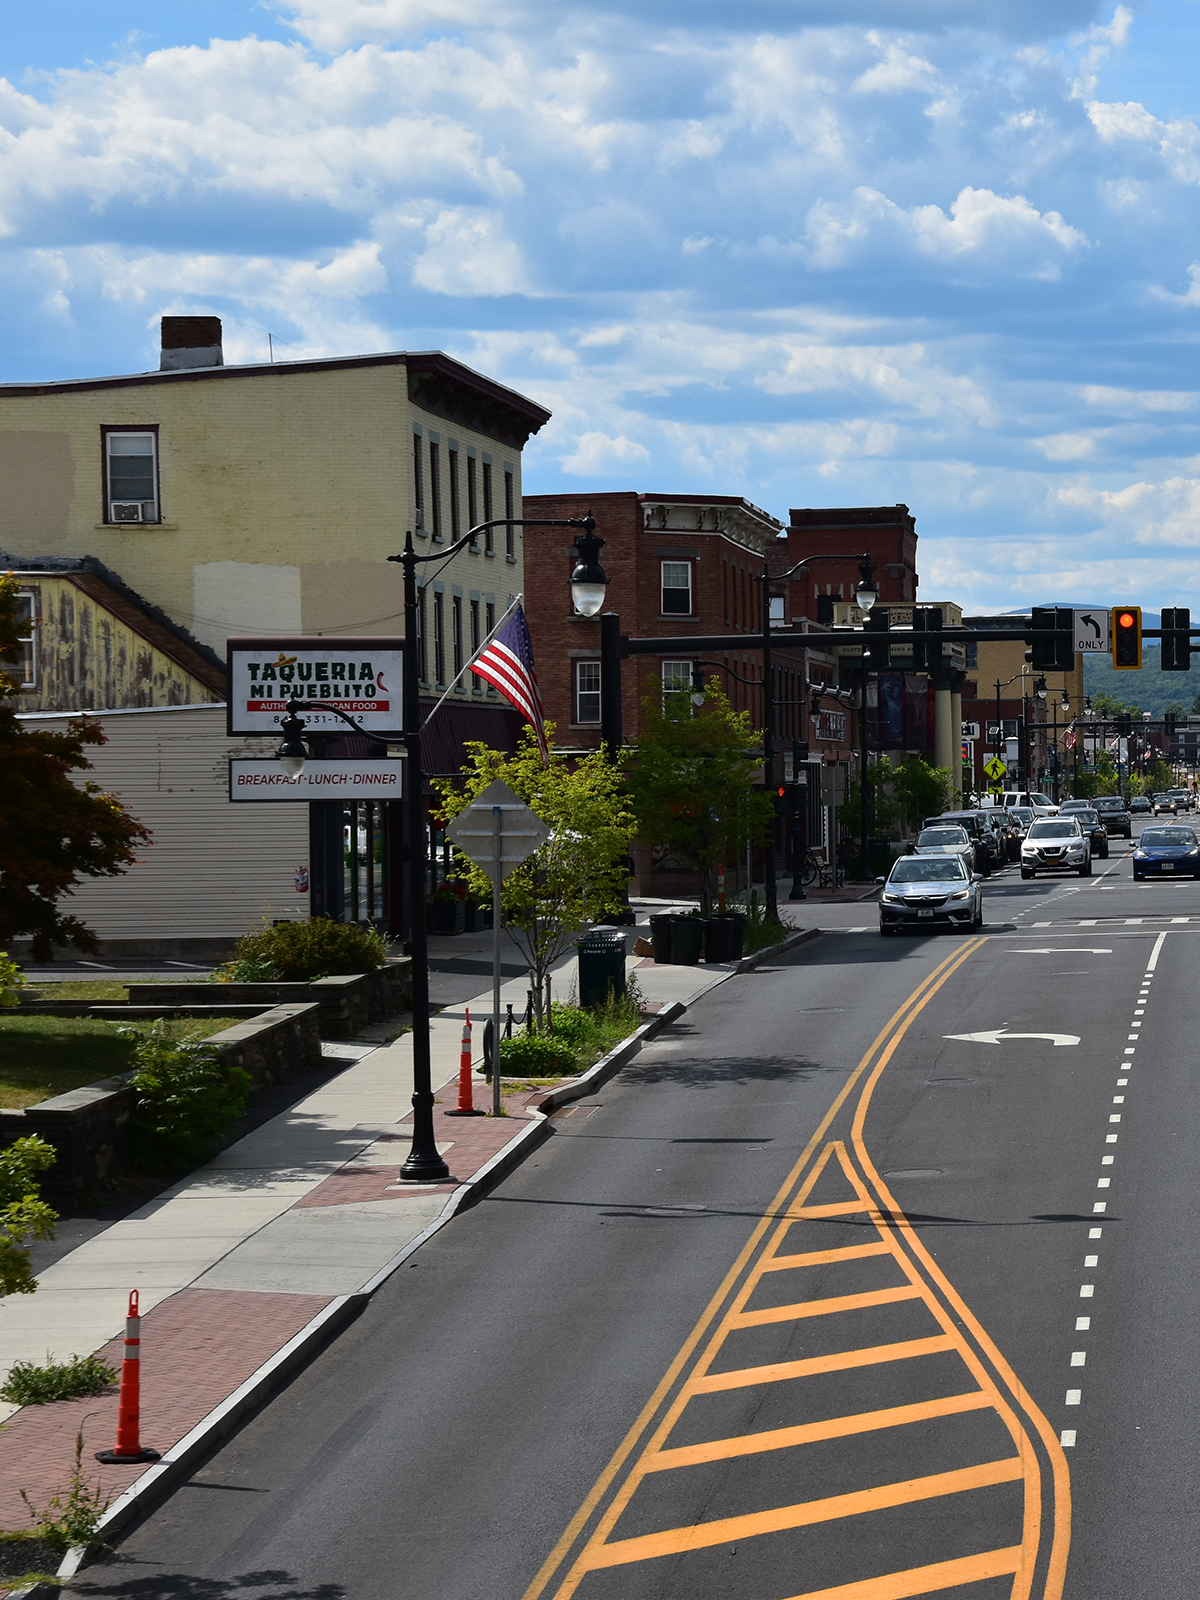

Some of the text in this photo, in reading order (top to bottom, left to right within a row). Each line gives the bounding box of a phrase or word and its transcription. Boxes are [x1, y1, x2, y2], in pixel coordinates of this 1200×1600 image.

[1078, 640, 1104, 649] ONLY
[247, 662, 375, 682] TAQUERIA
[250, 683, 376, 699] MI PUEBLITO
[352, 702, 377, 711] FOOD
[308, 774, 347, 785] LUNCH
[353, 774, 397, 785] DINNER
